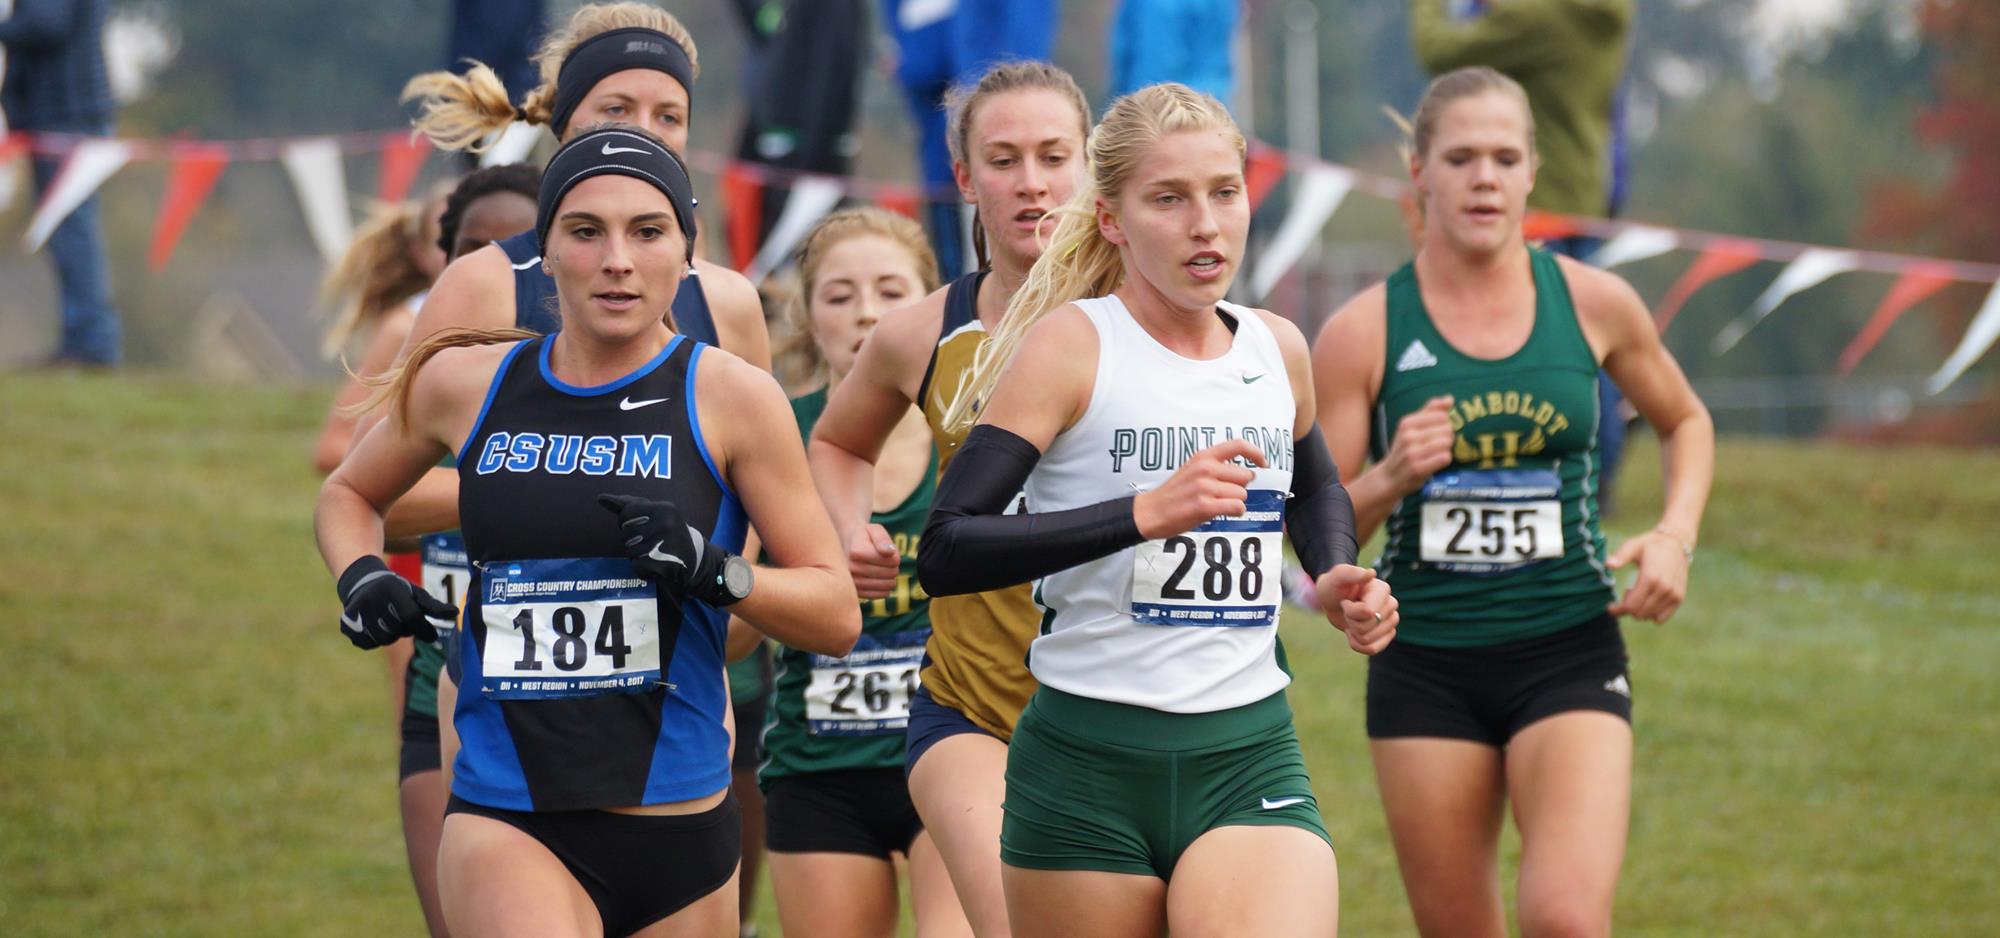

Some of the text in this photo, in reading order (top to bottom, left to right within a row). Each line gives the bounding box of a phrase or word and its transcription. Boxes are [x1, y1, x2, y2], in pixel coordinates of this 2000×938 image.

[1449, 391, 1569, 436] UMBOLDT
[476, 431, 672, 479] CSUSM
[1109, 426, 1216, 472] POINT
[1446, 508, 1537, 557] 255
[507, 578, 648, 593] CROSS COUNTRY CHAMPIONSHIPS
[1160, 536, 1263, 601] 288
[513, 605, 631, 671] 184
[521, 681, 542, 691] WEST
[541, 681, 568, 691] REGION
[579, 679, 618, 690] NOVEMBER
[627, 675, 645, 687] 2017
[830, 669, 917, 714] 261
